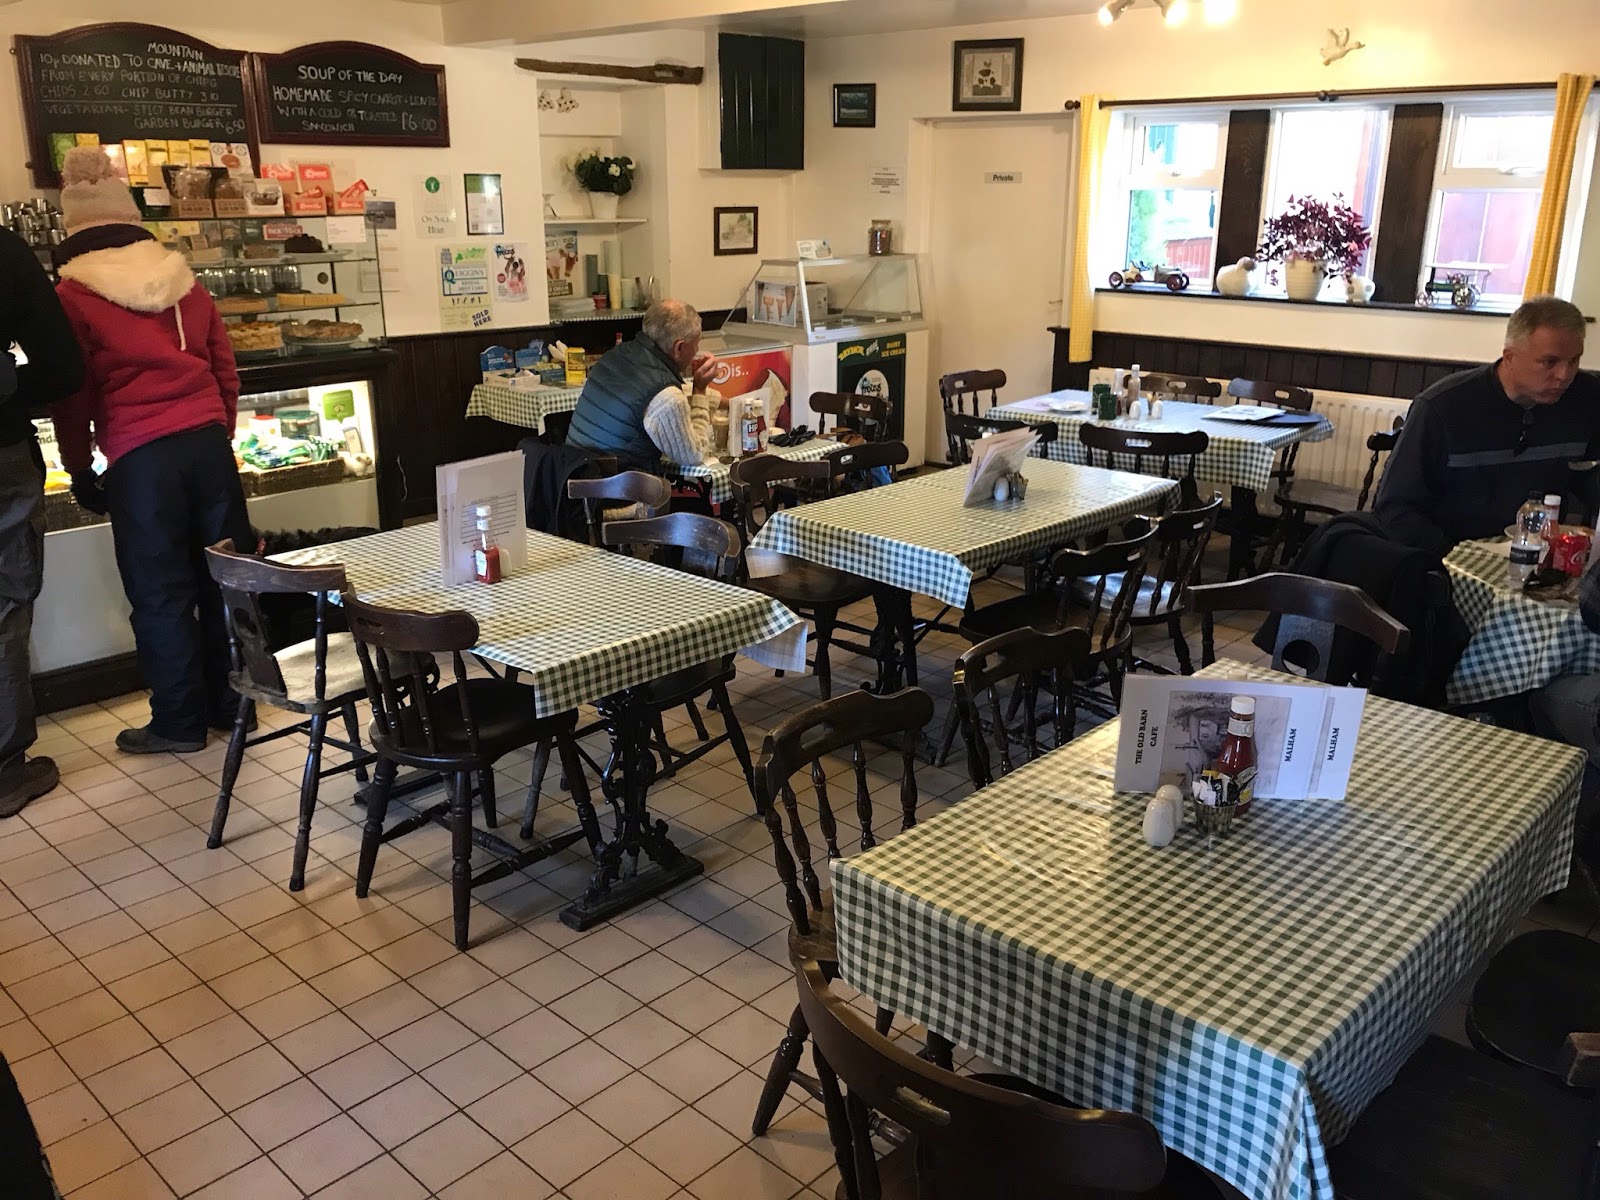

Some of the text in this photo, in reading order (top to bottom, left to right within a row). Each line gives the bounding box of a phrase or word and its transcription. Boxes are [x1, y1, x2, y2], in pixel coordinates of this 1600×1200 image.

[61, 54, 120, 68] DONATED
[123, 53, 142, 67] TO
[147, 58, 174, 69] CAVE
[42, 69, 75, 82] FROM
[79, 70, 114, 82] EVERY
[121, 69, 165, 83] PORTION
[168, 73, 180, 83] OF
[298, 65, 403, 84] SOUP OF THE DAY
[122, 87, 149, 98] CHIP
[155, 88, 193, 100] BUTTY
[273, 85, 332, 102] HOMEMADE
[169, 106, 194, 115] BEAN
[196, 107, 233, 117] BURGER
[135, 117, 179, 129] GARDEN
[182, 118, 225, 129] BURGER
[993, 174, 1013, 182] Private
[472, 309, 489, 321] SOLD
[474, 316, 492, 327] HERE
[1135, 709, 1148, 765] THE OLD BARN
[1150, 726, 1159, 747] CAFE
[1327, 727, 1340, 761] MALHAM
[1284, 728, 1297, 762] MALHAM
